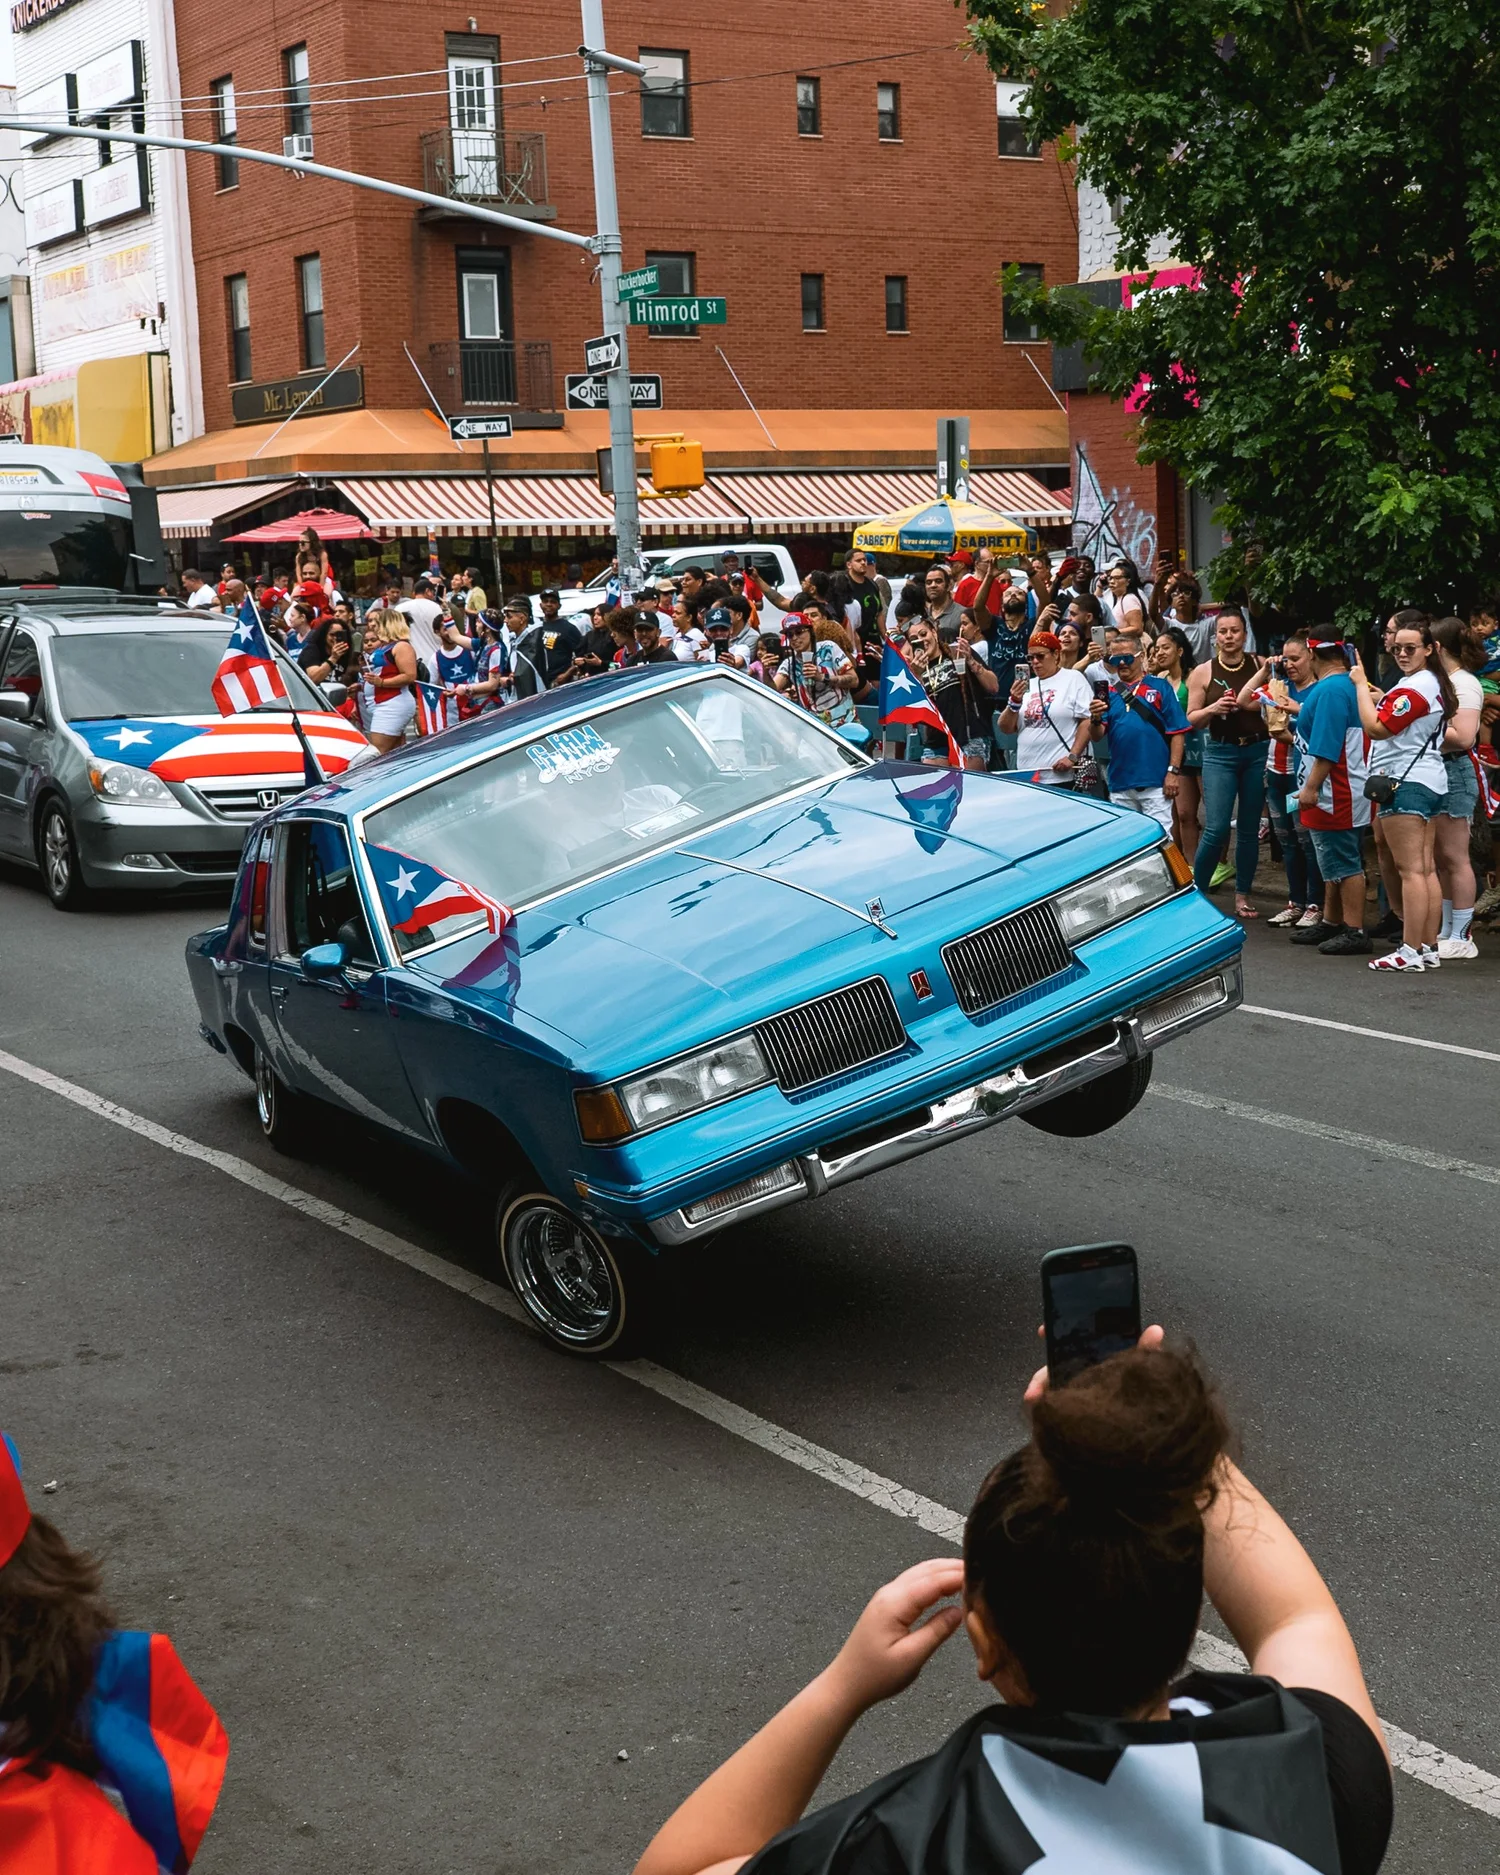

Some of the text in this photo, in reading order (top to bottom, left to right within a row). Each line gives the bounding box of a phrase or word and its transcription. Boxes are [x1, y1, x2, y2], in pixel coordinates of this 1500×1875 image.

[618, 269, 657, 291] Knickerbocker
[636, 300, 717, 321] Himrod St
[590, 345, 616, 364] ONE WAY
[263, 386, 325, 413] Mr. Lemon
[578, 385, 607, 399] ONE
[459, 423, 503, 433] ONE WAY
[856, 534, 895, 546] SABRETT
[960, 535, 1023, 548] SABRETT
[564, 762, 610, 784] NYC
